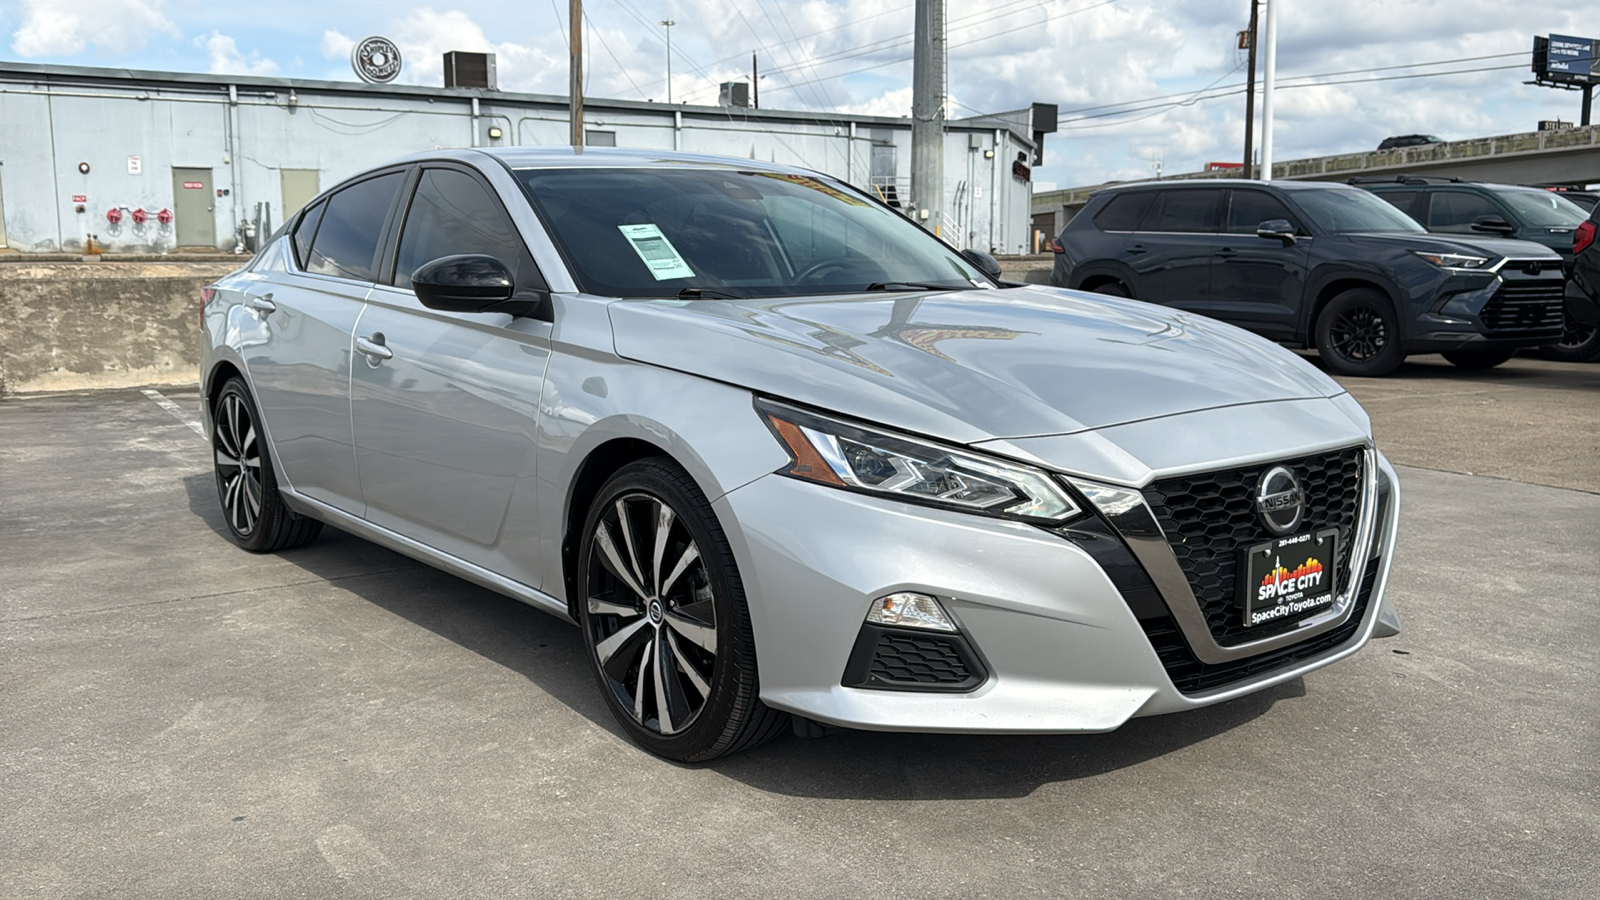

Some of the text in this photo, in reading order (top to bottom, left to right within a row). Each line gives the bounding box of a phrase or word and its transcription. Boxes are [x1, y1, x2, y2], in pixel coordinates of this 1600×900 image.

[1265, 493, 1300, 508] NISSAN
[1258, 571, 1323, 600] SPACE CITY
[1285, 592, 1304, 602] TOYOTA
[1251, 594, 1332, 624] SpaceCityToyota.com
